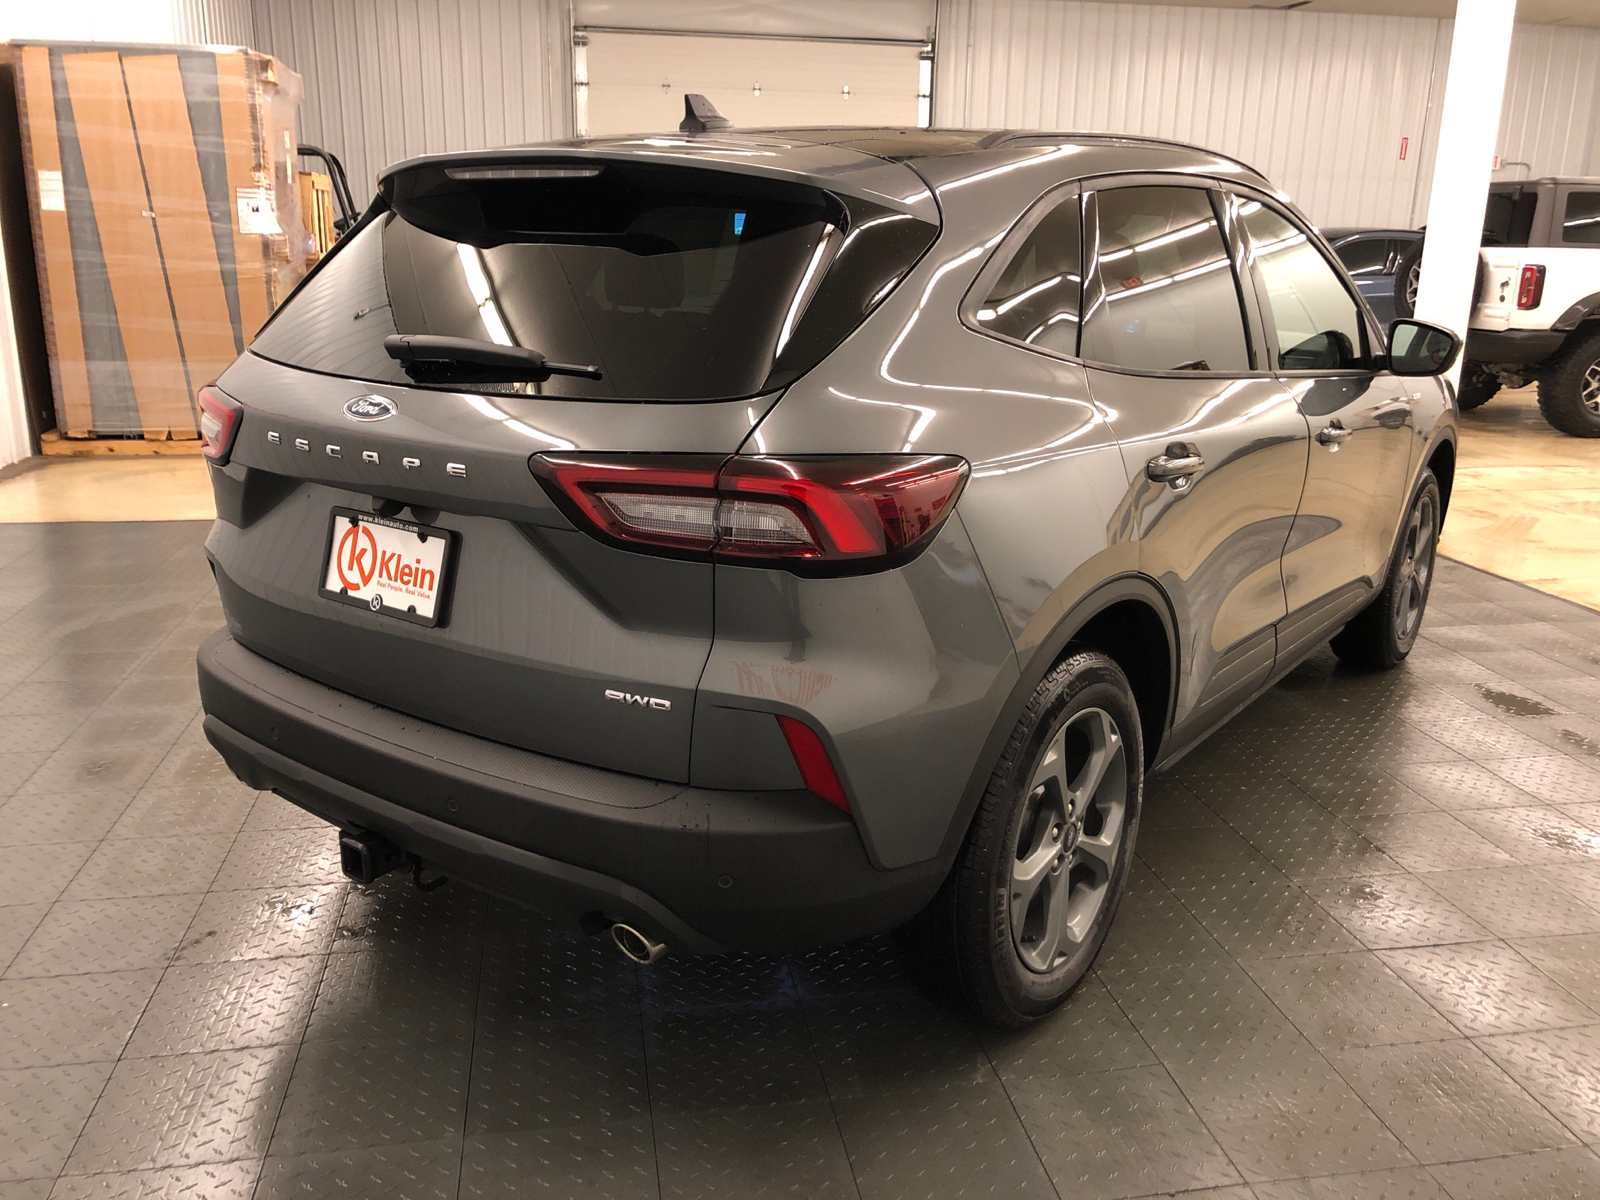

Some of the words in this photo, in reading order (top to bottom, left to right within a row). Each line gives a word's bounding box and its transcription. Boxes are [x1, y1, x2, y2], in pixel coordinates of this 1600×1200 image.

[267, 431, 467, 478] ESCAPE
[358, 514, 419, 533] www.kleinauto.com
[378, 550, 435, 591] Klein
[377, 580, 387, 588] Real
[387, 583, 403, 592] People.
[404, 587, 415, 596] Real
[417, 590, 431, 600] Value.
[604, 689, 672, 711] AWD
